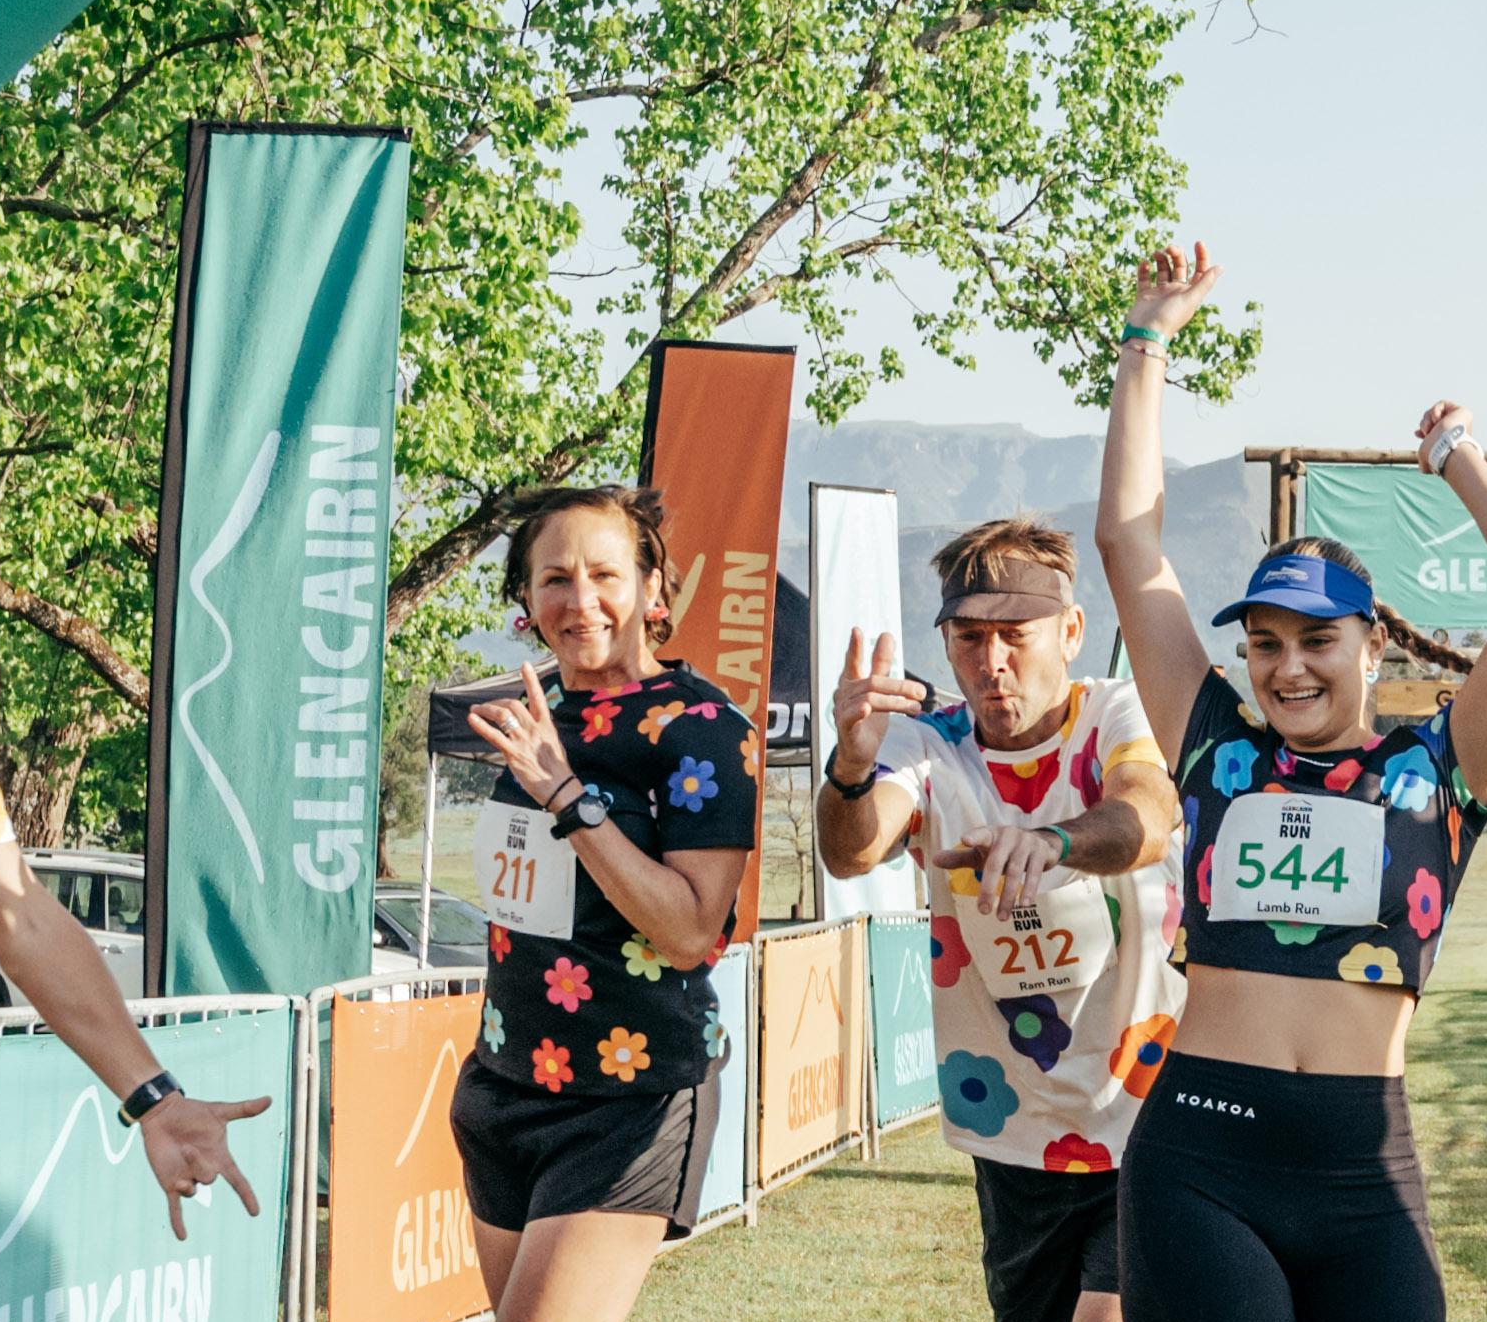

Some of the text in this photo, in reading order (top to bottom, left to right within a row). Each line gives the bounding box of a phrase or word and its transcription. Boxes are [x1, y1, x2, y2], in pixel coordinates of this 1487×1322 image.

[292, 424, 381, 893] GLENCAIRN
[1281, 812, 1312, 824] TRAIL
[1279, 824, 1311, 839] RUN
[507, 835, 525, 850] RUN
[492, 851, 536, 903] 211
[1235, 842, 1349, 893] 544
[1011, 909, 1039, 919] TRAIL
[1257, 901, 1320, 915] Lamb Run
[1014, 918, 1043, 931] RUN
[993, 929, 1080, 974] 212
[1019, 977, 1071, 990] Ram Run
[788, 1052, 844, 1131] GLENCAIRN
[1176, 1092, 1255, 1118] KOAKOA
[393, 1187, 480, 1292] GLENC
